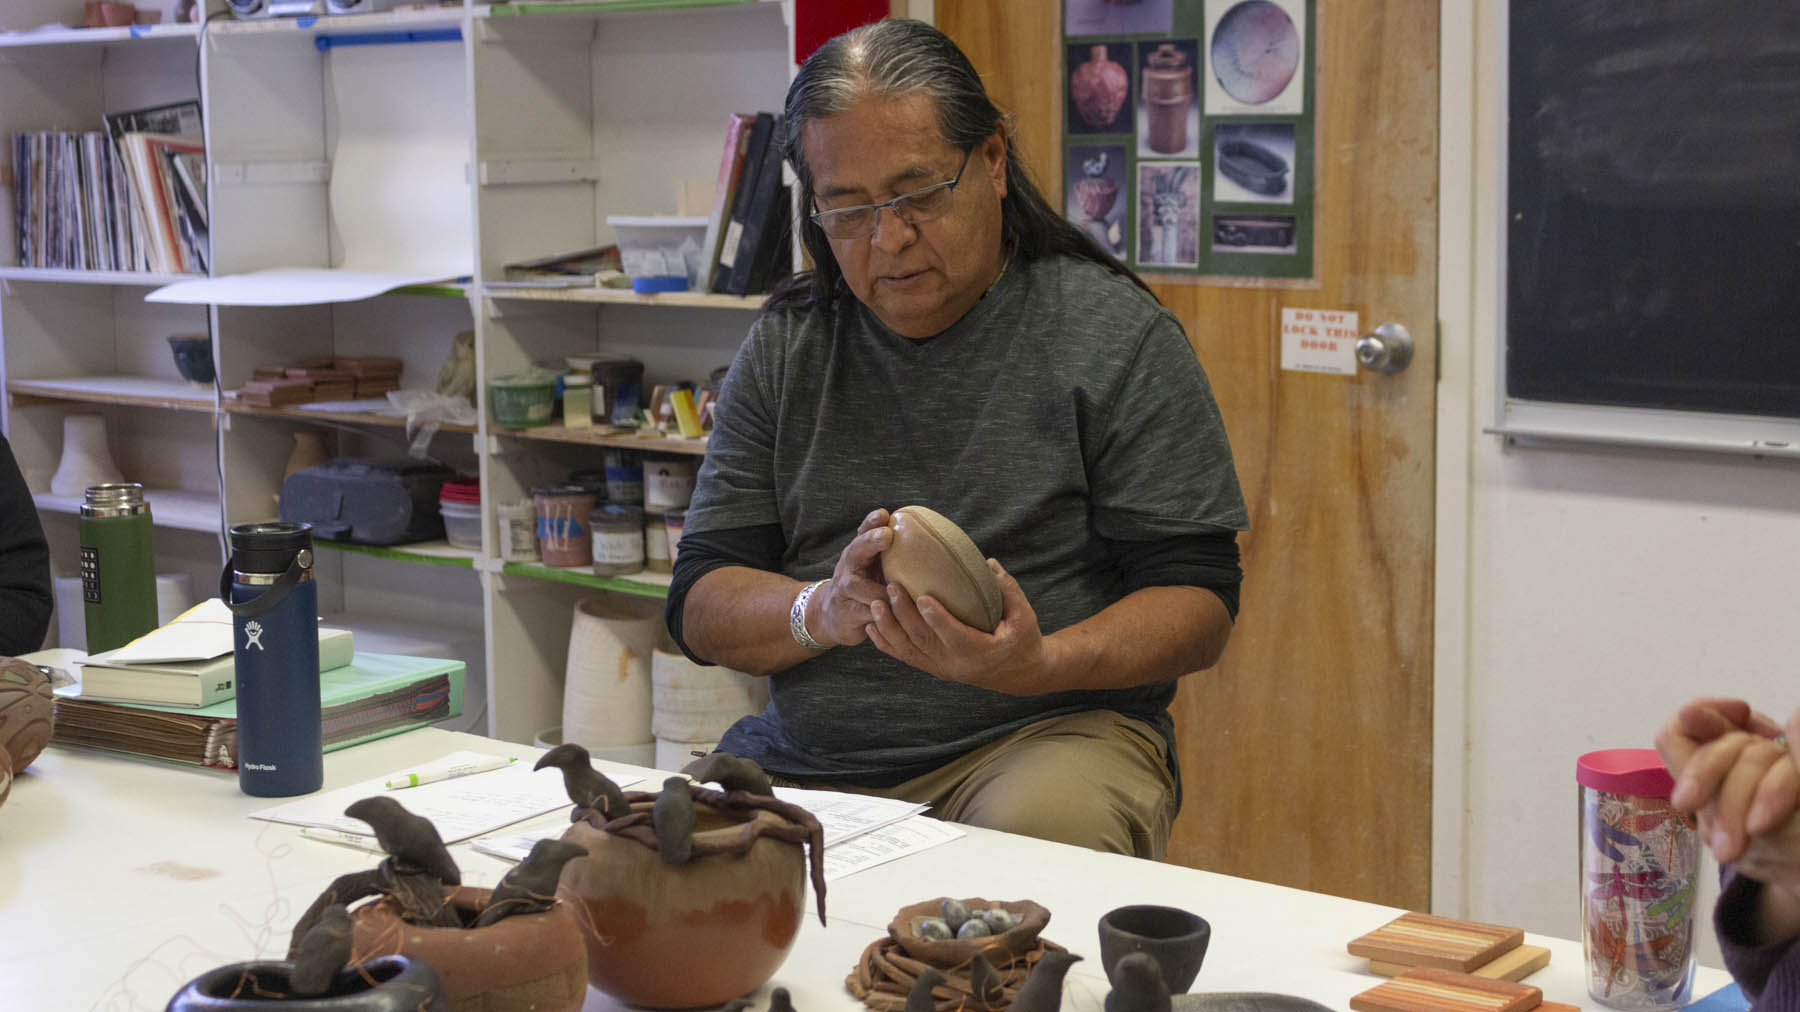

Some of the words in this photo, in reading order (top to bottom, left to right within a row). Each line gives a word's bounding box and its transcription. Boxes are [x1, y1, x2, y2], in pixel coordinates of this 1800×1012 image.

[1295, 312, 1313, 321] DO
[1321, 312, 1345, 324] NOT
[1283, 324, 1318, 336] LOCK
[1325, 327, 1358, 337] THIS
[1301, 340, 1337, 352] DOOR
[244, 762, 259, 772] Hydro
[260, 763, 277, 771] Flask
